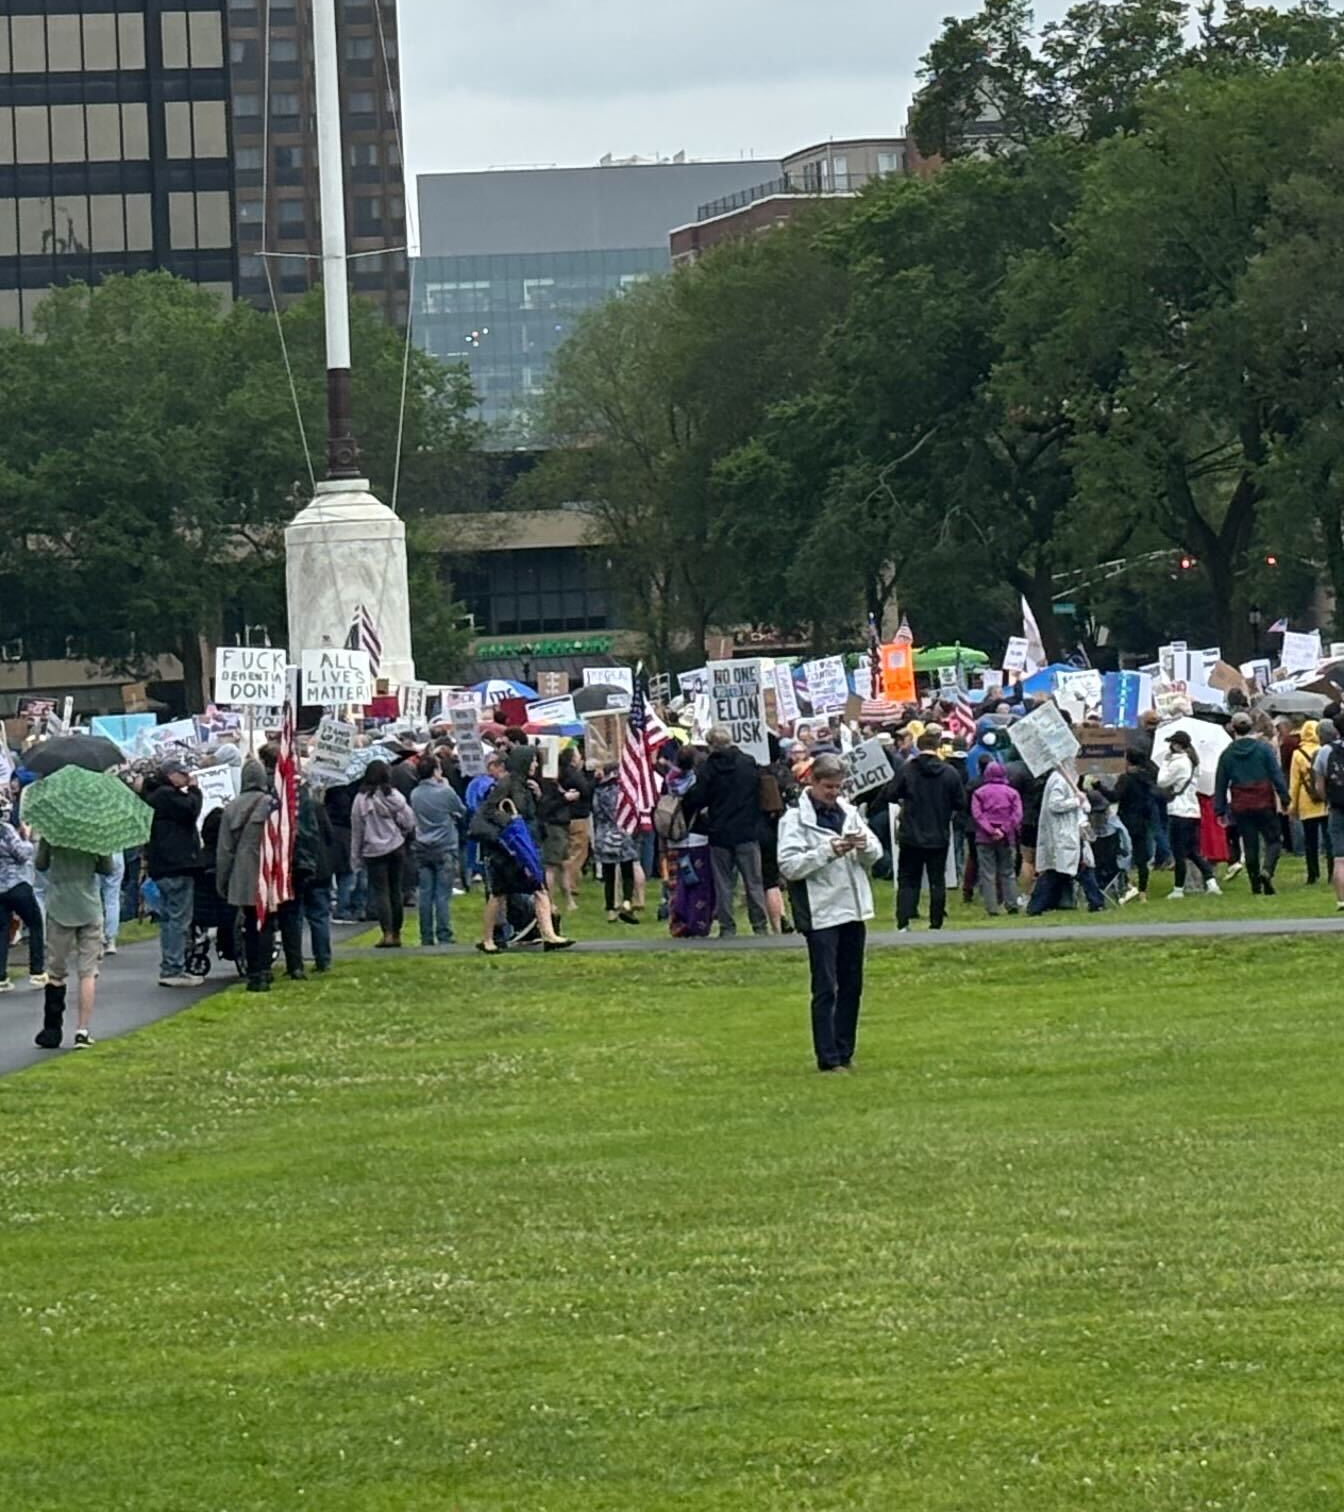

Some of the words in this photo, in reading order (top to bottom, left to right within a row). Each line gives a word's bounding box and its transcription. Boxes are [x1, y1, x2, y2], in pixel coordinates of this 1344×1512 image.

[222, 650, 284, 671] FUCK
[320, 653, 359, 670] ALL
[221, 671, 282, 684] DEMENTIA
[307, 670, 366, 684] LIVES
[713, 669, 730, 684] NO
[734, 666, 757, 683] ONE
[230, 683, 276, 700] DON!
[717, 694, 760, 721] ELON
[732, 720, 762, 743] USK
[841, 764, 888, 796] PLICIT
